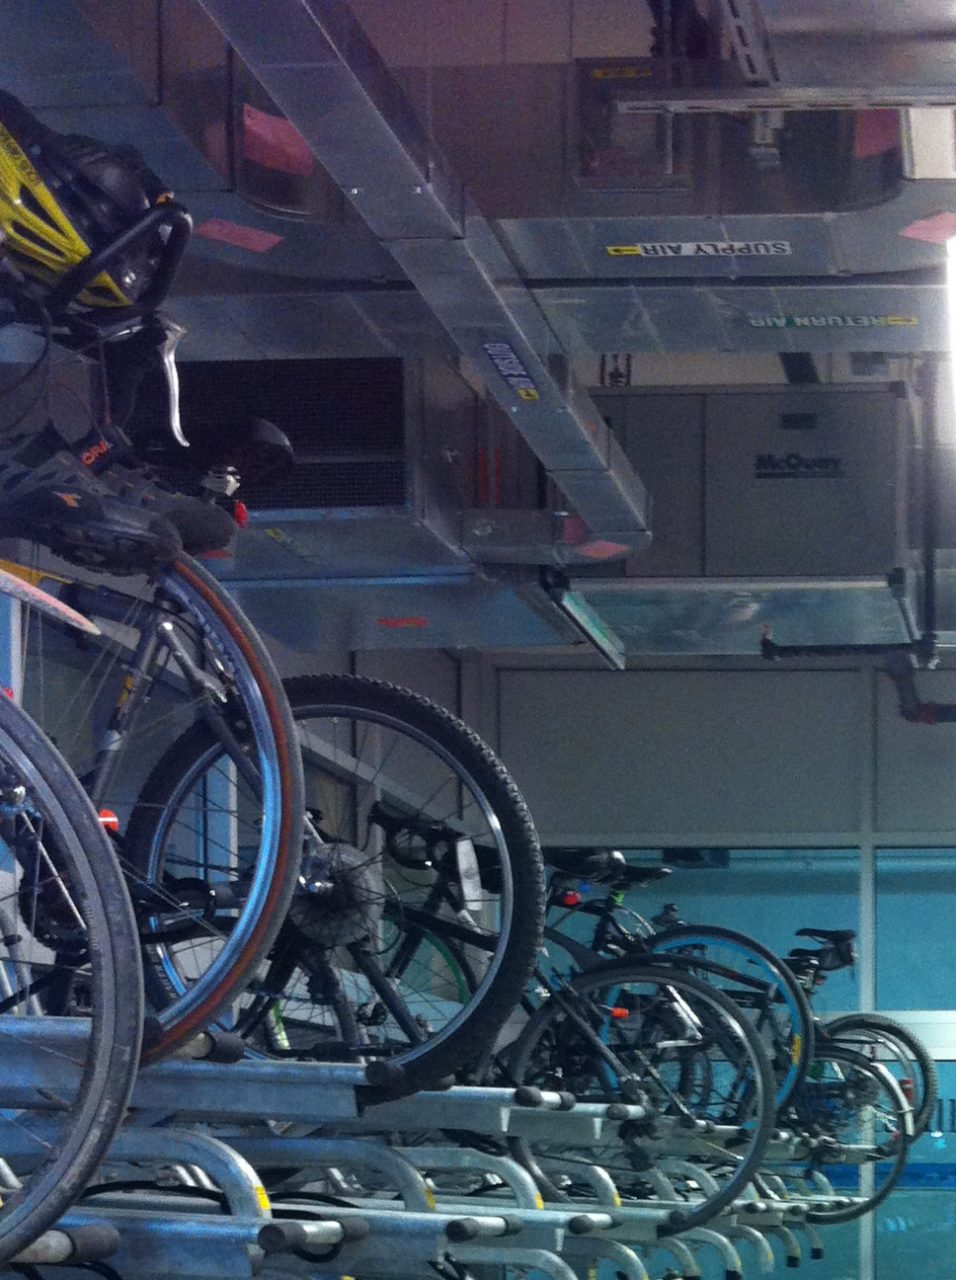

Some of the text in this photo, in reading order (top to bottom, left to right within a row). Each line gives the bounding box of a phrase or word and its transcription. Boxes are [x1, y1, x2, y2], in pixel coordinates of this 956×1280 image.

[642, 242, 787, 256] SUPPLY AIR
[751, 315, 886, 328] RETURN AIR
